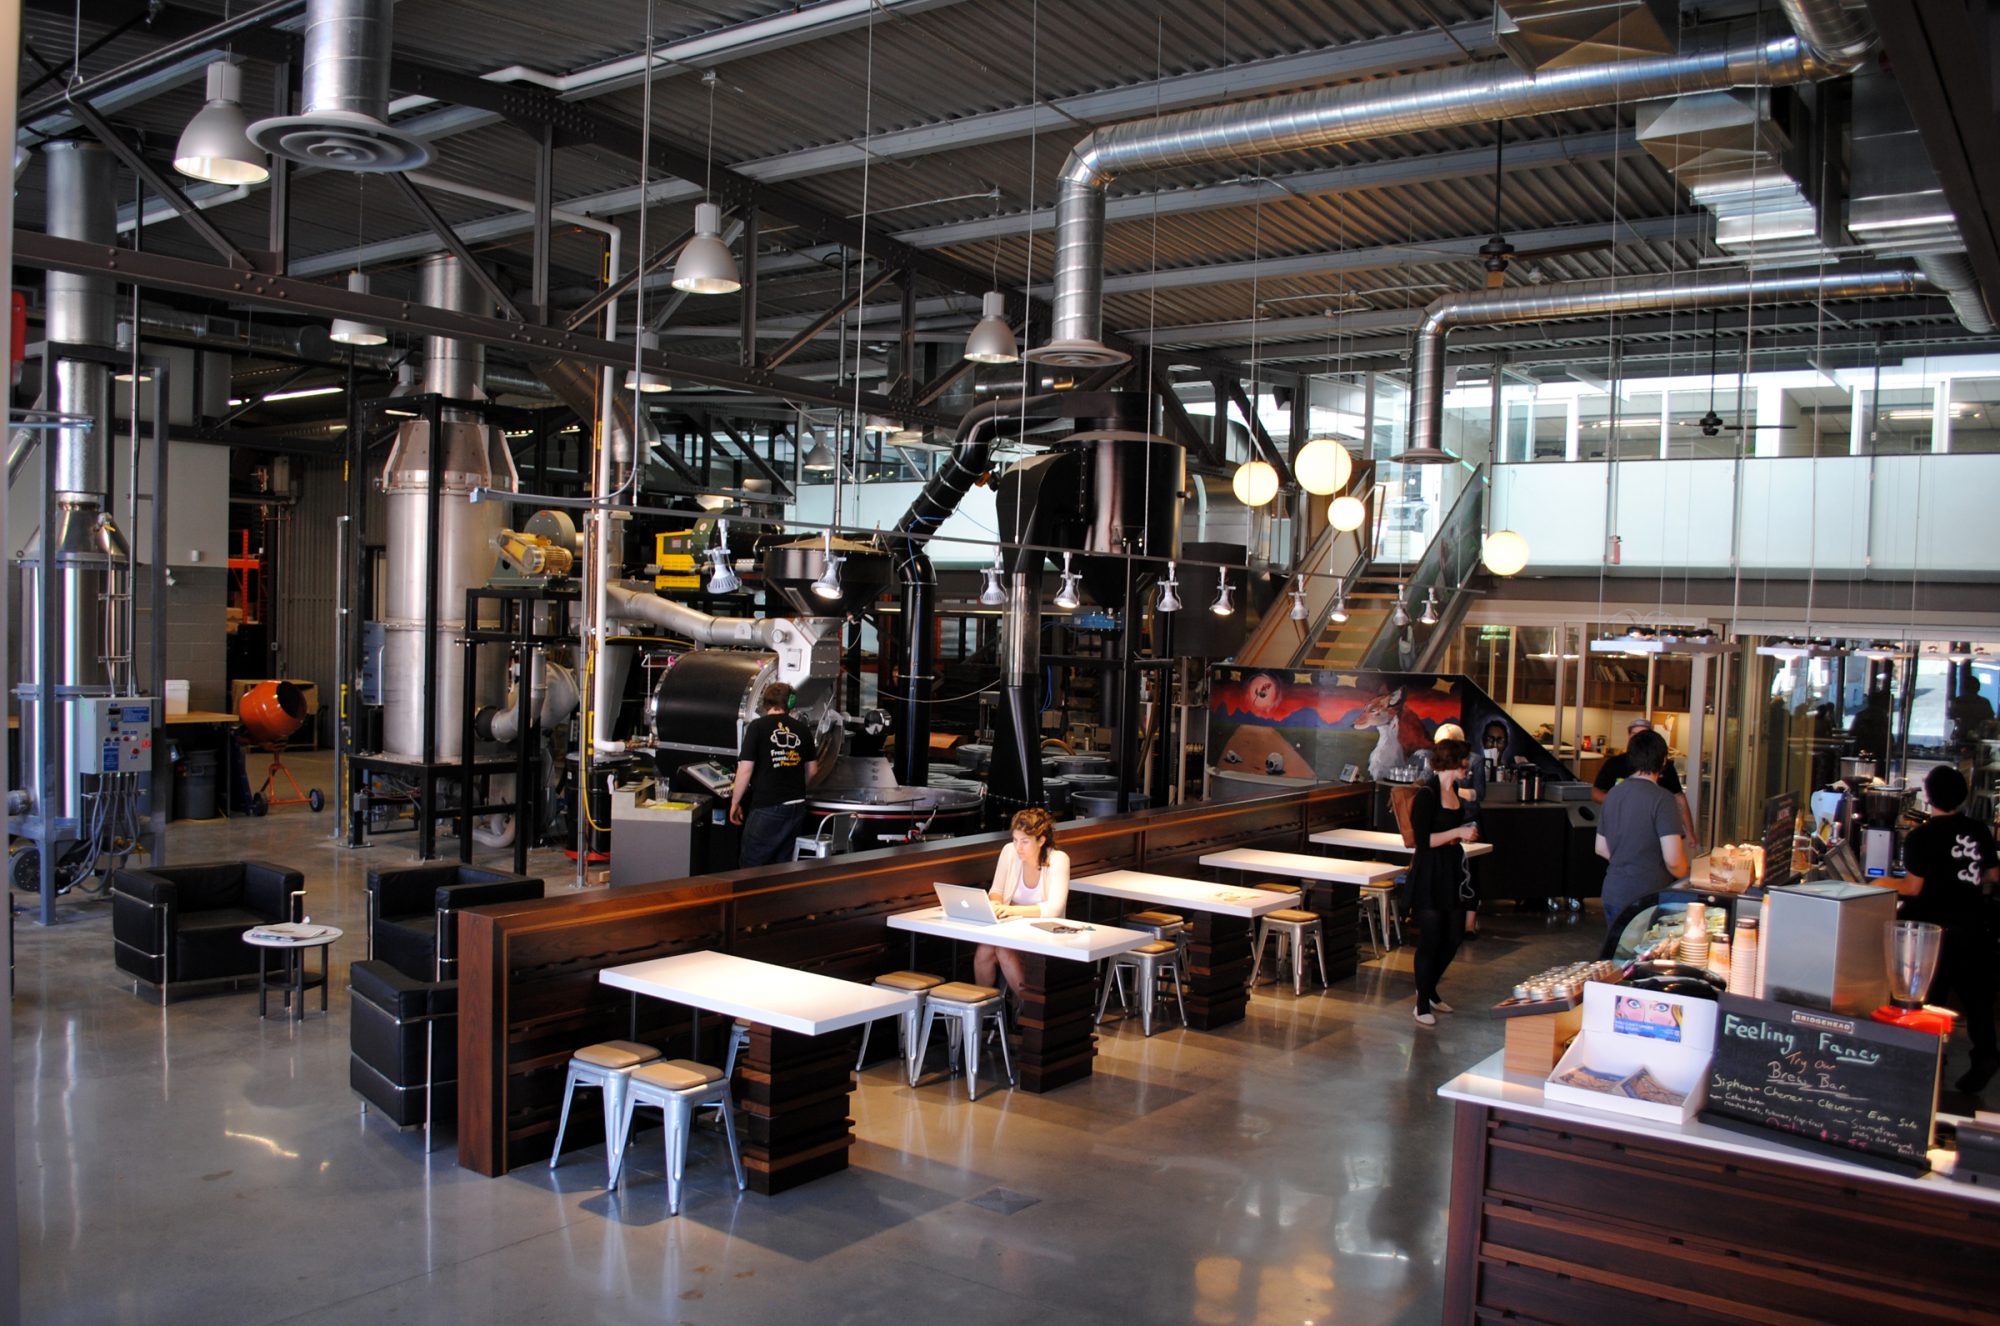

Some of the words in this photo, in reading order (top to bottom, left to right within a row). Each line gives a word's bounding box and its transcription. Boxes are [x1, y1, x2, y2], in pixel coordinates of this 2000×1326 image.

[1794, 1014, 1851, 1031] BRIDGEHEAD
[1724, 1013, 1795, 1055] Feeling
[1819, 1032, 1881, 1063] Fancy
[1785, 1051, 1808, 1073] Try
[1768, 1061, 1806, 1086] Brew
[1815, 1073, 1847, 1091] Bar
[1817, 1099, 1852, 1112] Clever
